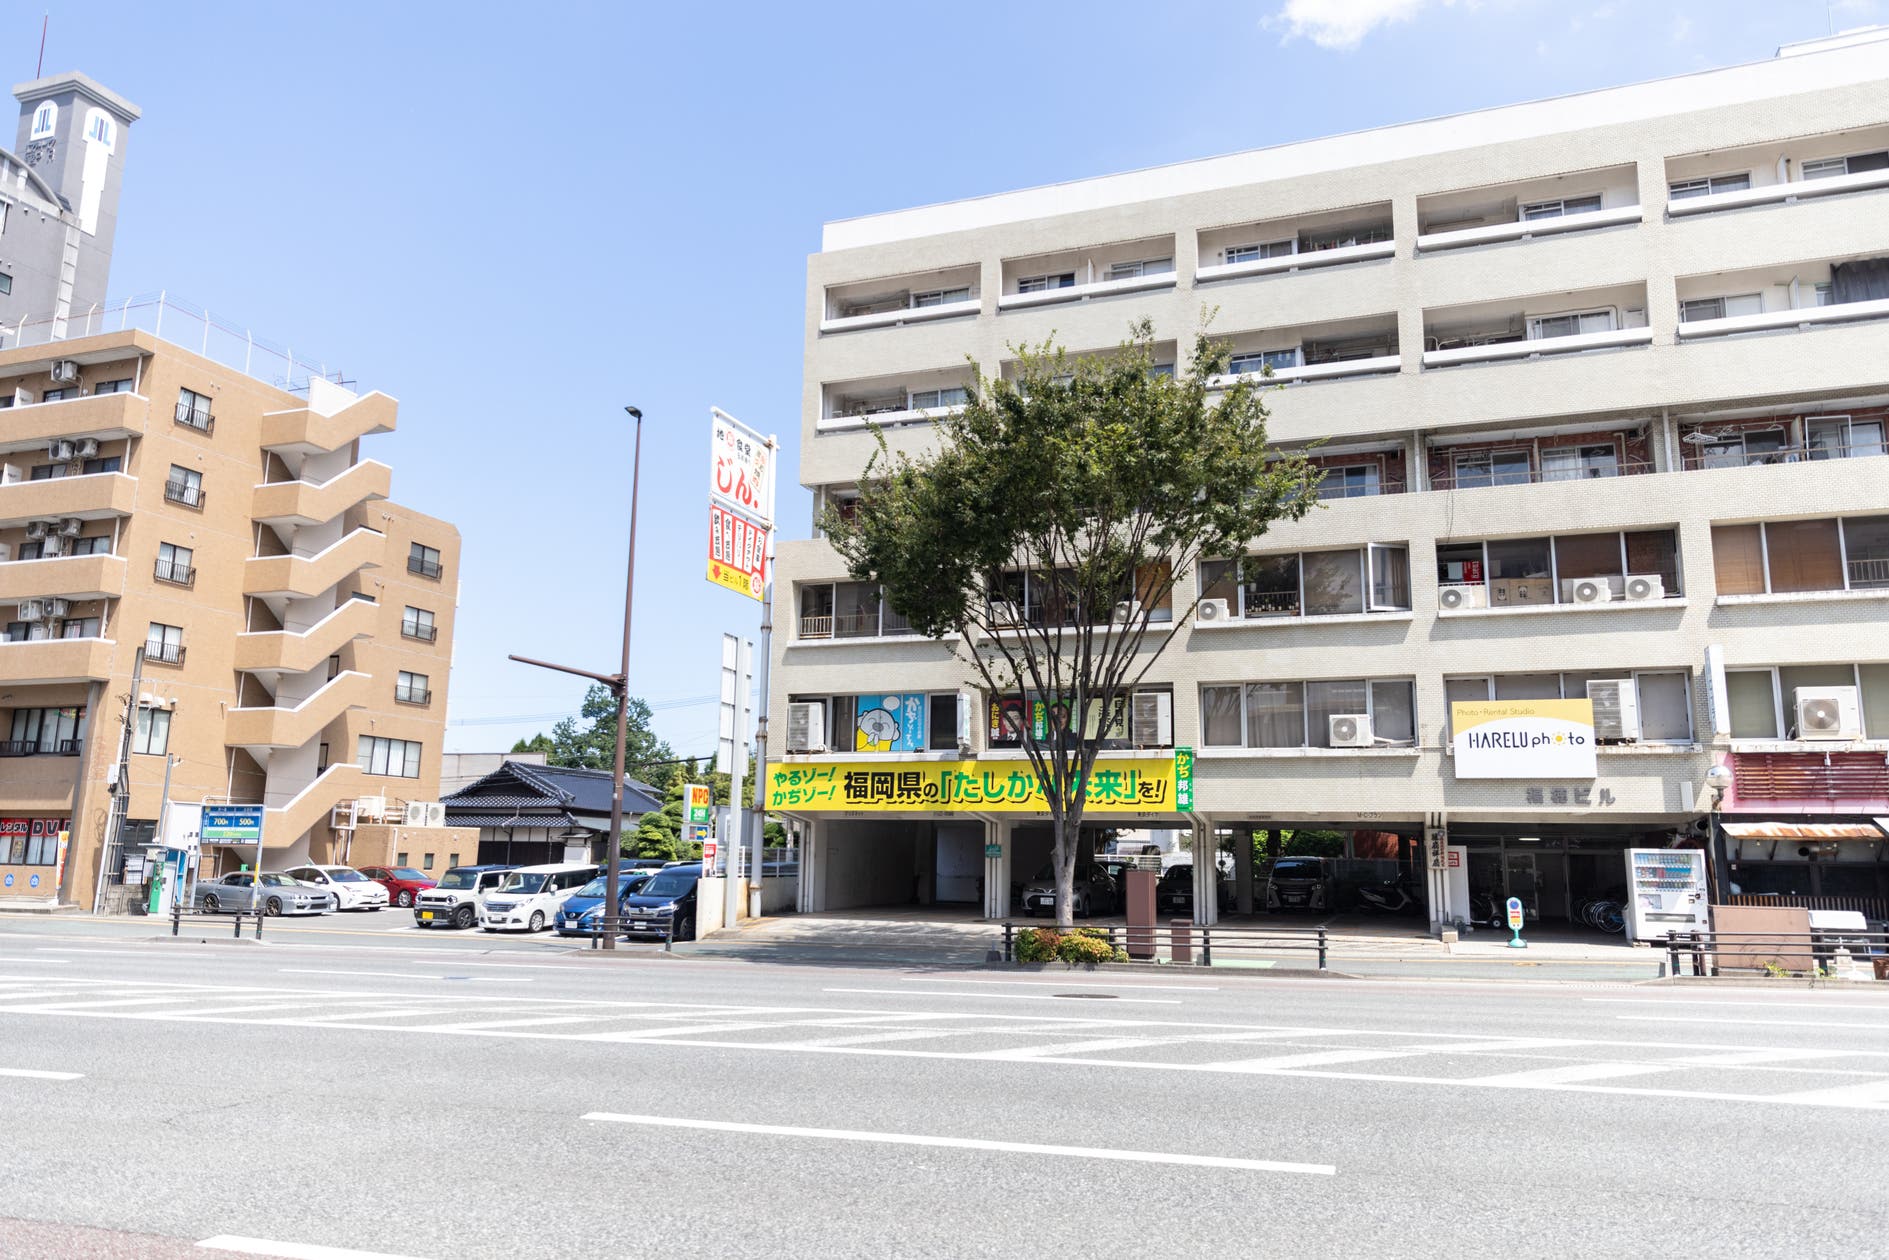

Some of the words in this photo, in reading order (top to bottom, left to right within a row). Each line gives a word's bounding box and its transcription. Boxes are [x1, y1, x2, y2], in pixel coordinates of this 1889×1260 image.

[1510, 707, 1535, 716] Studio
[1468, 731, 1529, 749] HARELU
[1176, 752, 1190, 805] かぢ邦雄
[691, 787, 709, 804] NPC
